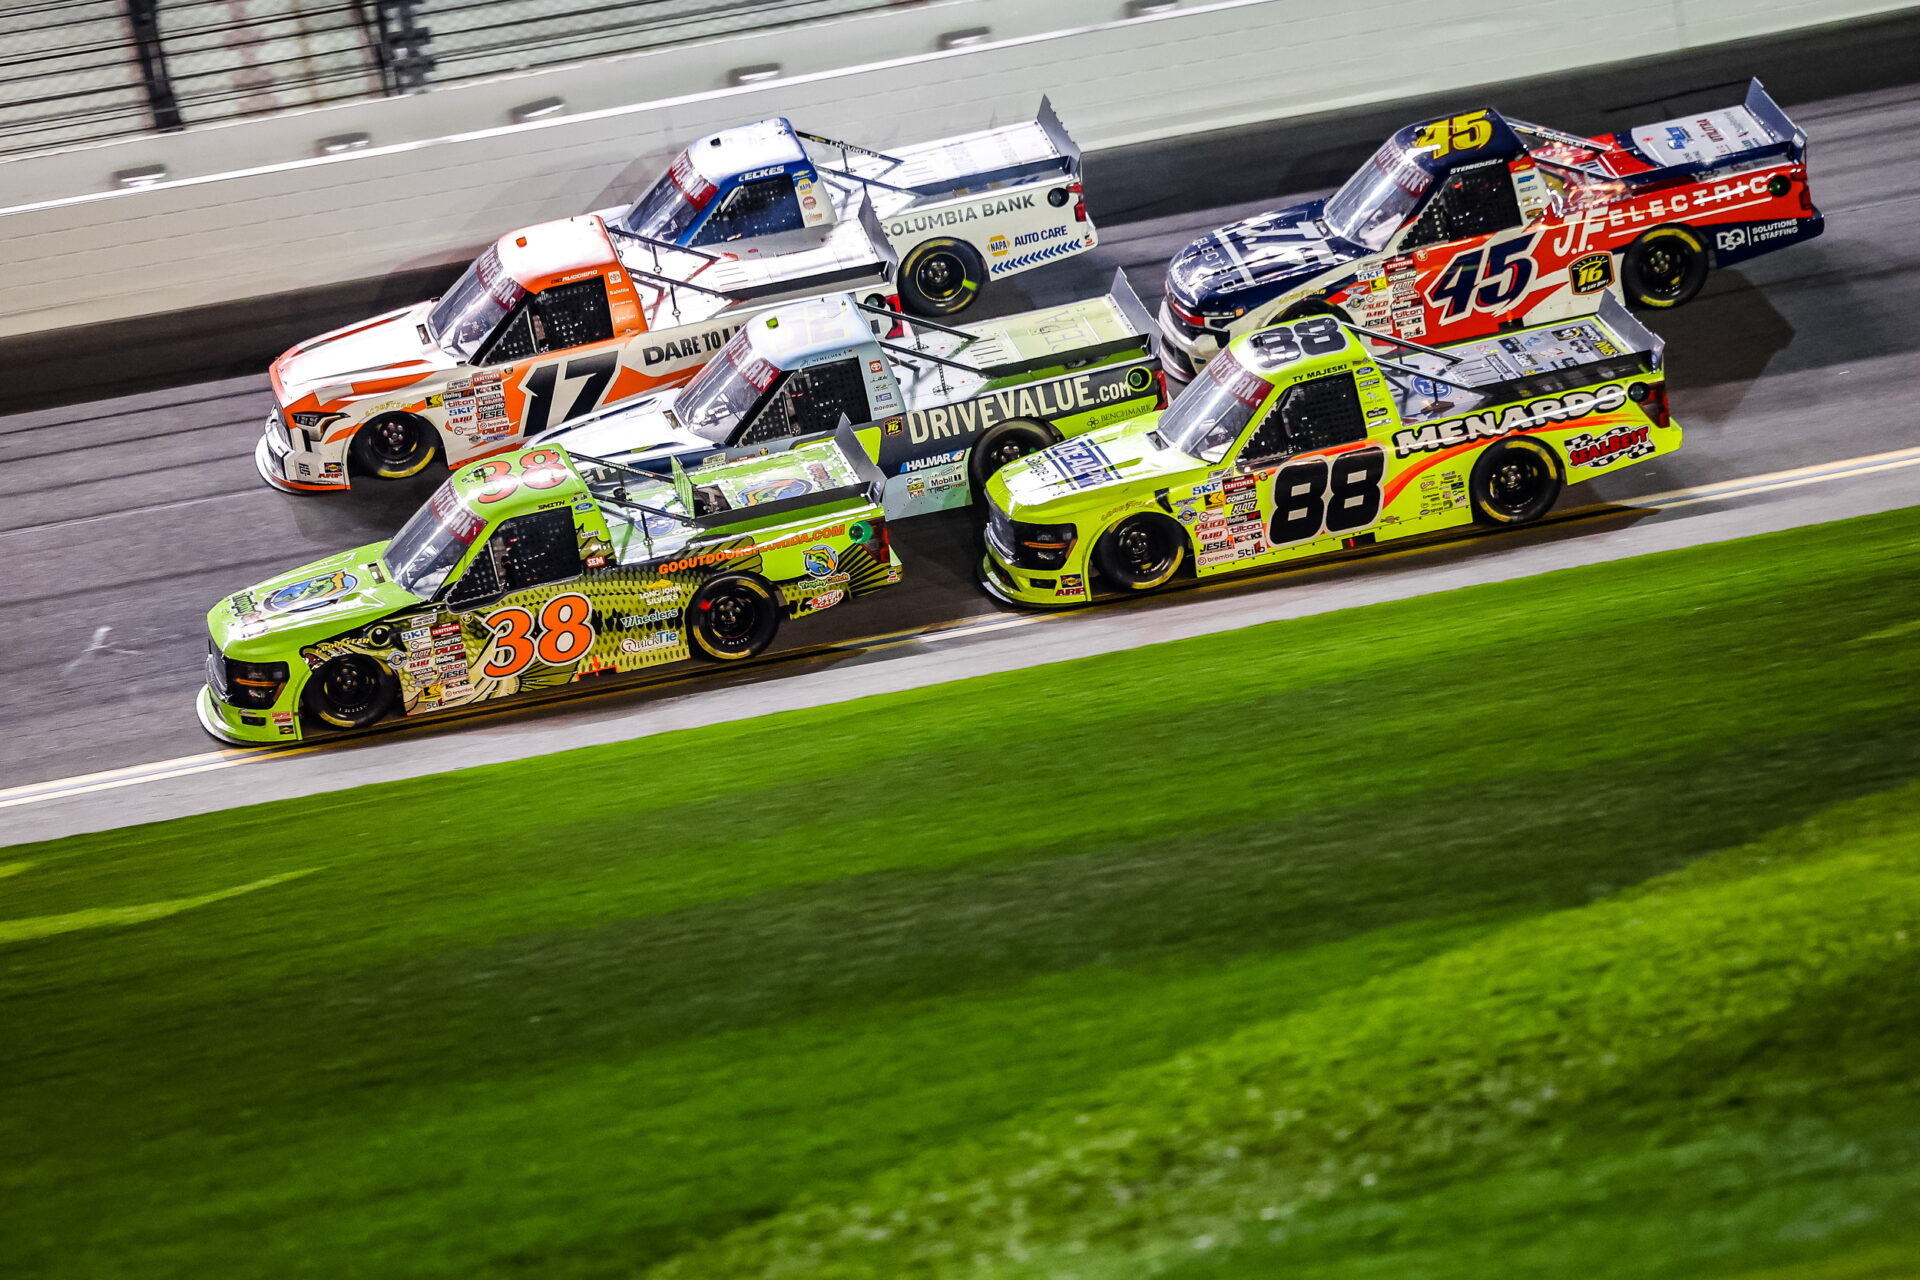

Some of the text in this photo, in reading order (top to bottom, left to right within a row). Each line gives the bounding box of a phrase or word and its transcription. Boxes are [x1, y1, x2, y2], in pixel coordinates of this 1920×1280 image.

[1416, 109, 1492, 159] 45
[1450, 158, 1497, 174] STENHOUSE
[983, 193, 1035, 218] BANK
[1608, 175, 1768, 227] ELECTRIC
[1752, 218, 1798, 235] SOLUTIONS
[990, 225, 1068, 252] NAPA AUTO CARE
[1760, 227, 1799, 241] STAFFING
[1359, 270, 1383, 281] SKF
[1388, 271, 1417, 282] COMETIC
[1428, 232, 1537, 319] 45
[1577, 266, 1603, 287] 16
[1394, 308, 1423, 318] tilton
[1361, 316, 1392, 328] JESEL
[642, 336, 701, 366] DARE
[702, 331, 721, 351] TO
[1250, 317, 1347, 369] 88
[1292, 363, 1348, 383] TY MAJESKI
[523, 350, 619, 439] 17
[447, 399, 475, 408] tilton
[449, 405, 476, 416] SKF
[478, 402, 505, 413] COMETIC
[477, 409, 507, 421] JESEL
[1101, 404, 1151, 421] BENCHMARK
[1394, 384, 1627, 459] MENARDS
[1570, 426, 1649, 467] SEALBEST
[603, 461, 625, 470] FORD
[624, 466, 655, 478] RACING
[906, 453, 951, 472] HALMAR
[478, 449, 567, 504] 38
[930, 476, 954, 487] Mobil
[1192, 481, 1221, 496] SKF
[1224, 479, 1254, 490] CRAFTSMAN
[1226, 491, 1256, 503] COMETIC
[1270, 446, 1384, 545] 88
[537, 500, 566, 511] SMITH
[1194, 519, 1225, 531] CALICO
[1227, 515, 1248, 525] Holley
[1230, 523, 1261, 534] tilton
[658, 523, 846, 576] GOOUTDOORSFLORIDA.COM
[1200, 540, 1232, 553] JESEL
[1237, 545, 1266, 559] Stilo
[586, 556, 605, 567] SEM
[1207, 553, 1234, 563] brembo
[800, 574, 849, 589] TrophyCatch
[639, 585, 682, 600] LONG JOHN
[819, 596, 841, 608] CASH
[621, 609, 679, 628] Wheelers
[402, 628, 429, 641] SKF
[483, 595, 592, 678] 38
[621, 630, 679, 653] QuickTie
[434, 637, 461, 647] COMETIC
[436, 655, 456, 664] Holley
[440, 662, 466, 672] tilton
[441, 669, 469, 679] JESEL
